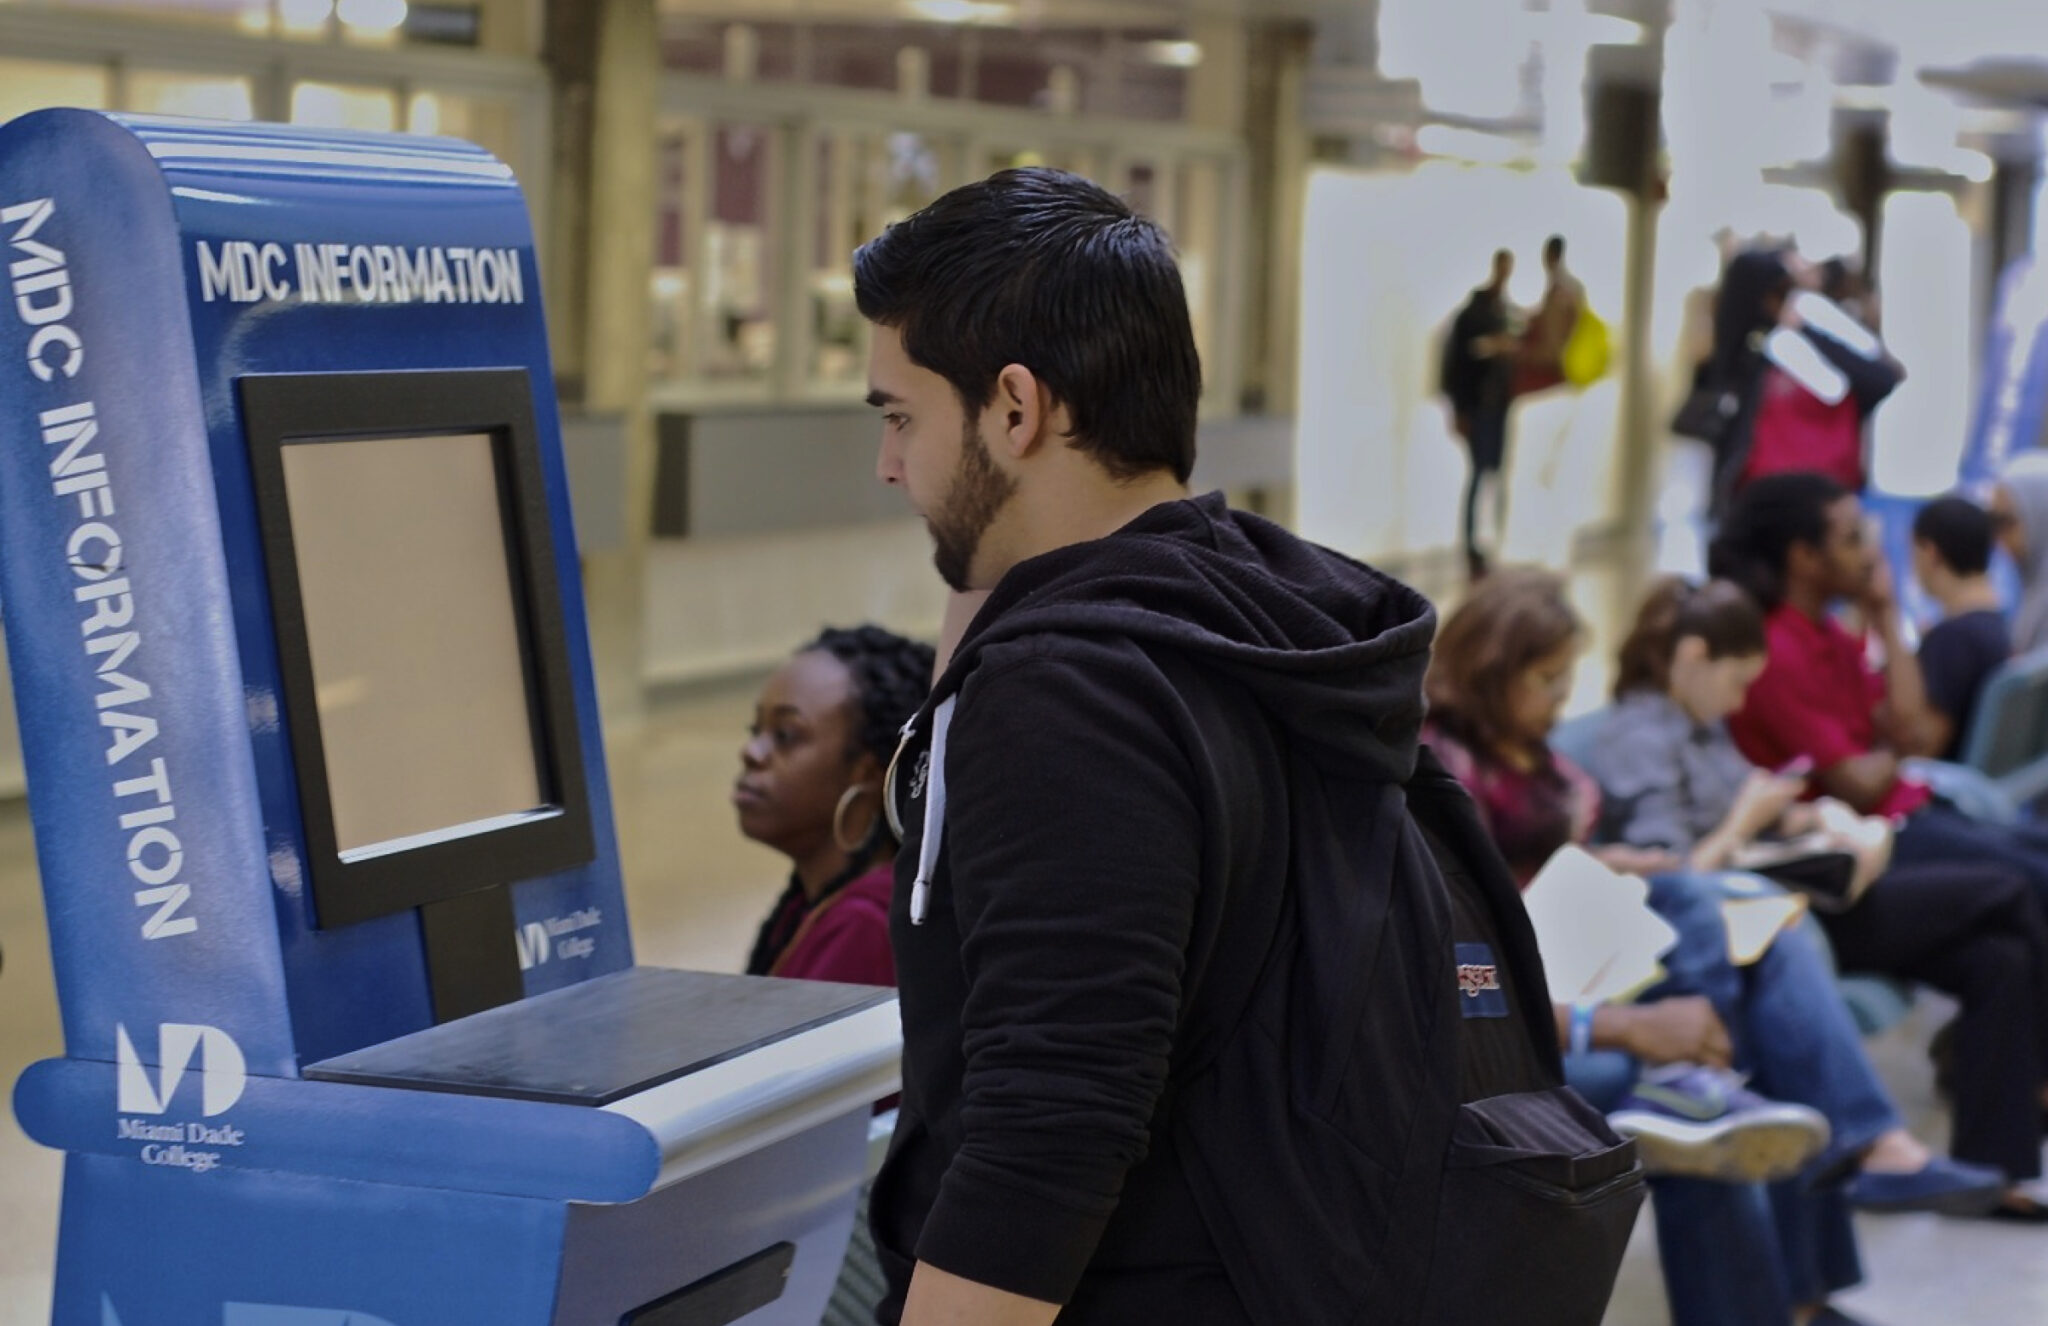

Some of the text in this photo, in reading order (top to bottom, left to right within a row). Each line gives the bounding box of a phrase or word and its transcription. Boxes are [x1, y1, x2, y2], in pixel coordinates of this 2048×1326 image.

[196, 240, 524, 304] MDC INFORMATION
[0, 197, 199, 940] MDC INFORMATION
[117, 1118, 245, 1147] Miami Dade
[140, 1143, 221, 1173] College
